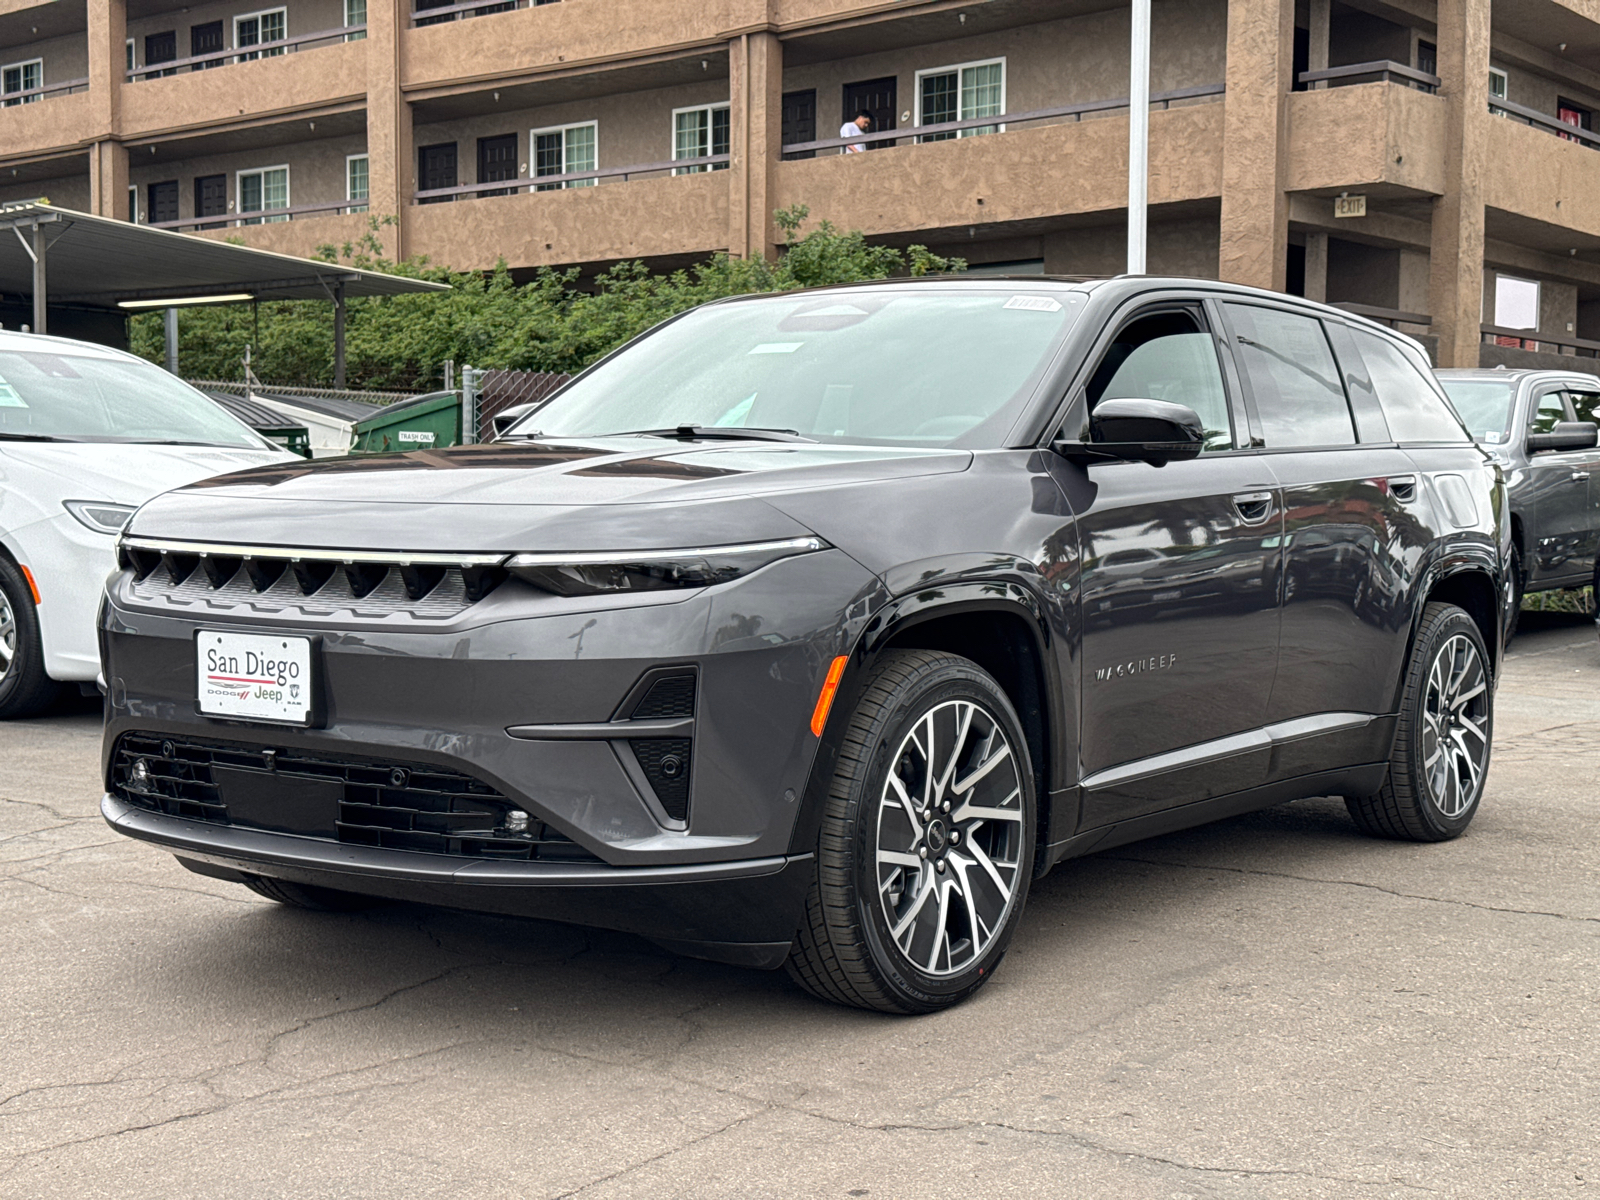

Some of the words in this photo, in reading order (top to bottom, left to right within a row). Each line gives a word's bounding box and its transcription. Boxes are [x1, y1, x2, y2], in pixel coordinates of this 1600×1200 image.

[1340, 199, 1361, 214] EXIT
[207, 648, 239, 674] San
[245, 651, 300, 687] Diego
[1095, 653, 1176, 681] WAGONEER
[254, 685, 283, 704] Jeep
